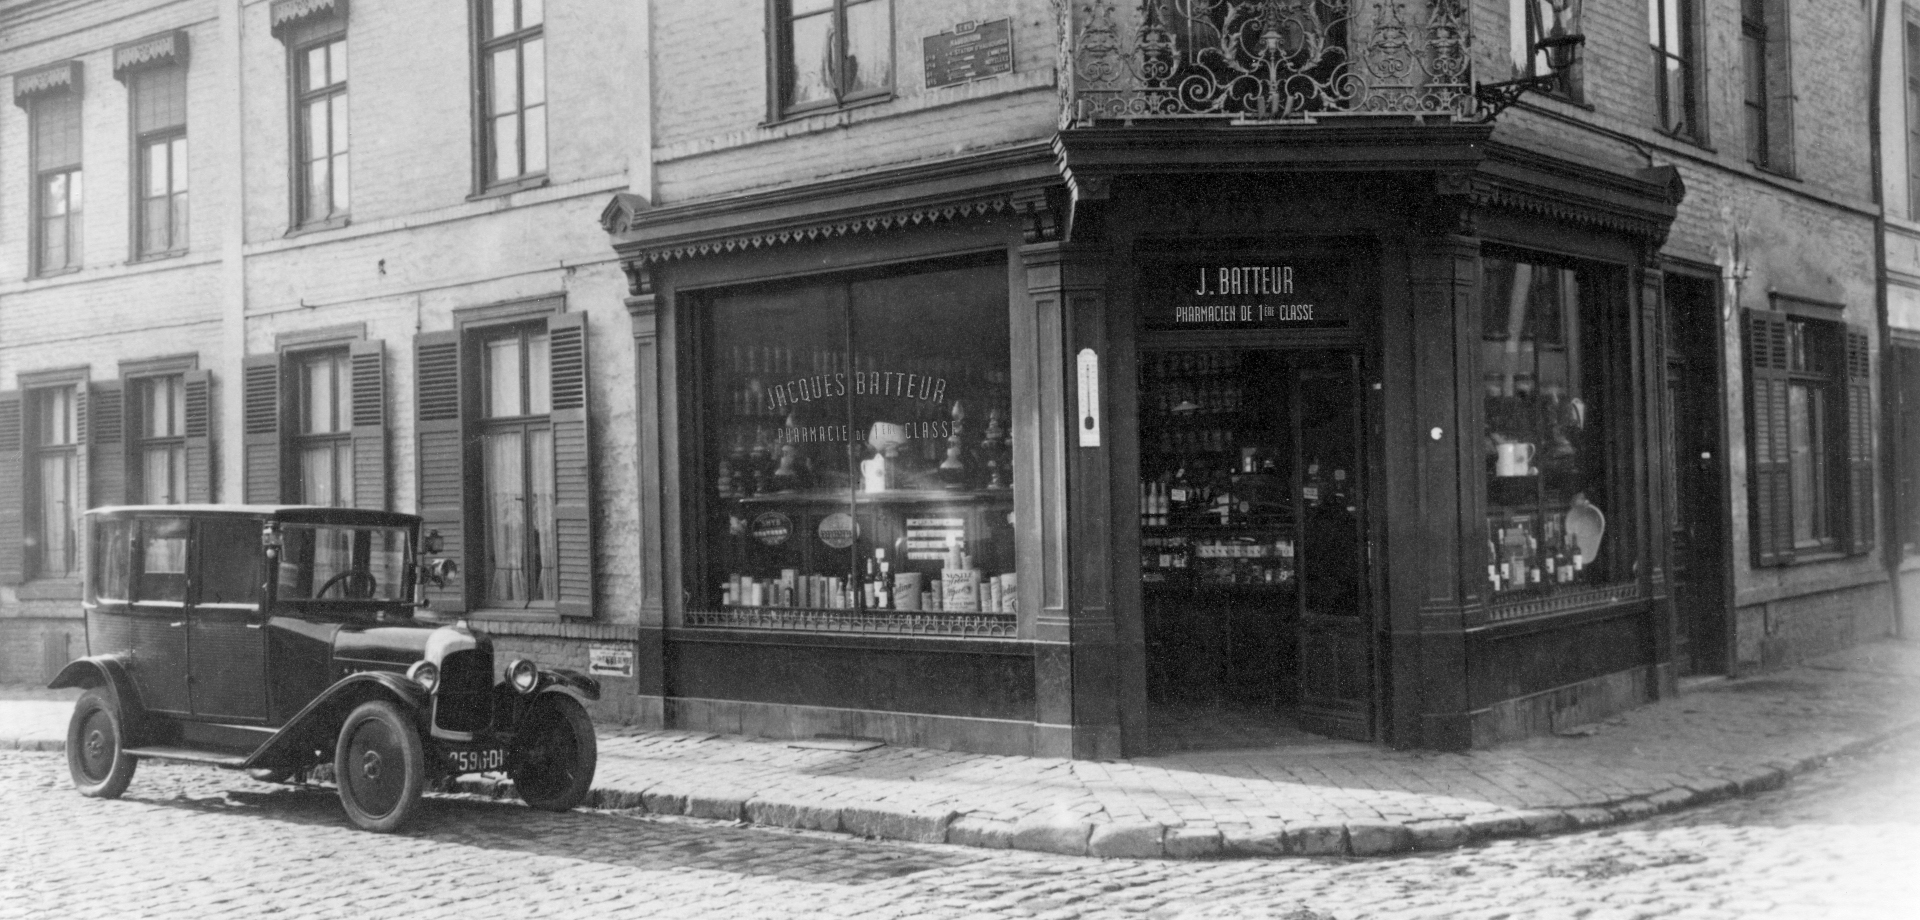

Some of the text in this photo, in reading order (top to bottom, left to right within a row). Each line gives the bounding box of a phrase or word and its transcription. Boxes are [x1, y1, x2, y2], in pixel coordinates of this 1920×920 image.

[1196, 266, 1294, 296] J. BATTEUR
[1176, 305, 1236, 322] PHARMACIEN
[1240, 305, 1253, 321] DE
[1279, 304, 1314, 321] CLASSE
[766, 371, 947, 411] JACQUES BATTEUR
[777, 425, 848, 443] PHARMACIE
[856, 430, 866, 441] DE
[904, 420, 957, 439] CLASSE
